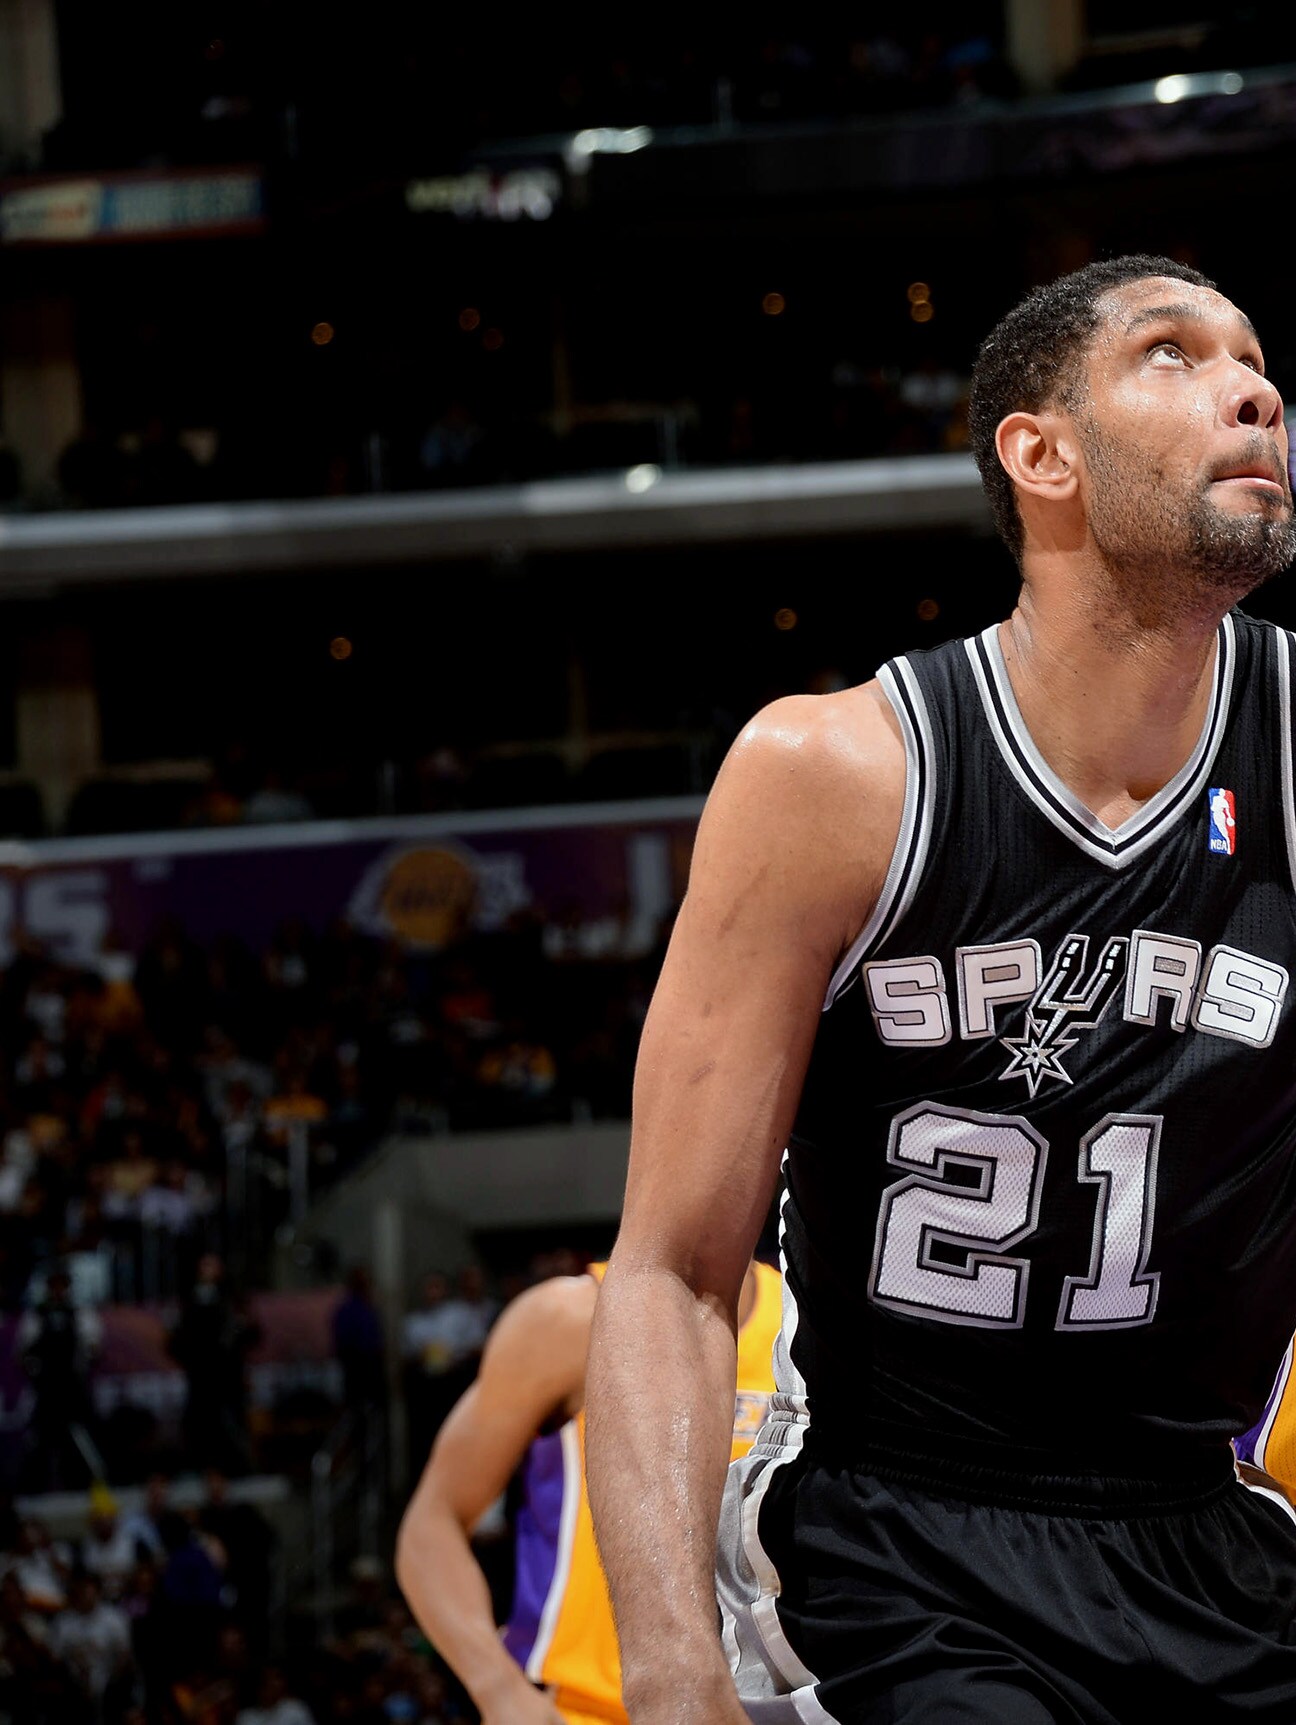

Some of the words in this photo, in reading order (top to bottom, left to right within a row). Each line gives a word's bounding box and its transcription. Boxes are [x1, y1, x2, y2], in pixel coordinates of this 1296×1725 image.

[1210, 838, 1228, 851] NBA
[865, 929, 1290, 1097] SPURS
[867, 1100, 1164, 1331] 21
